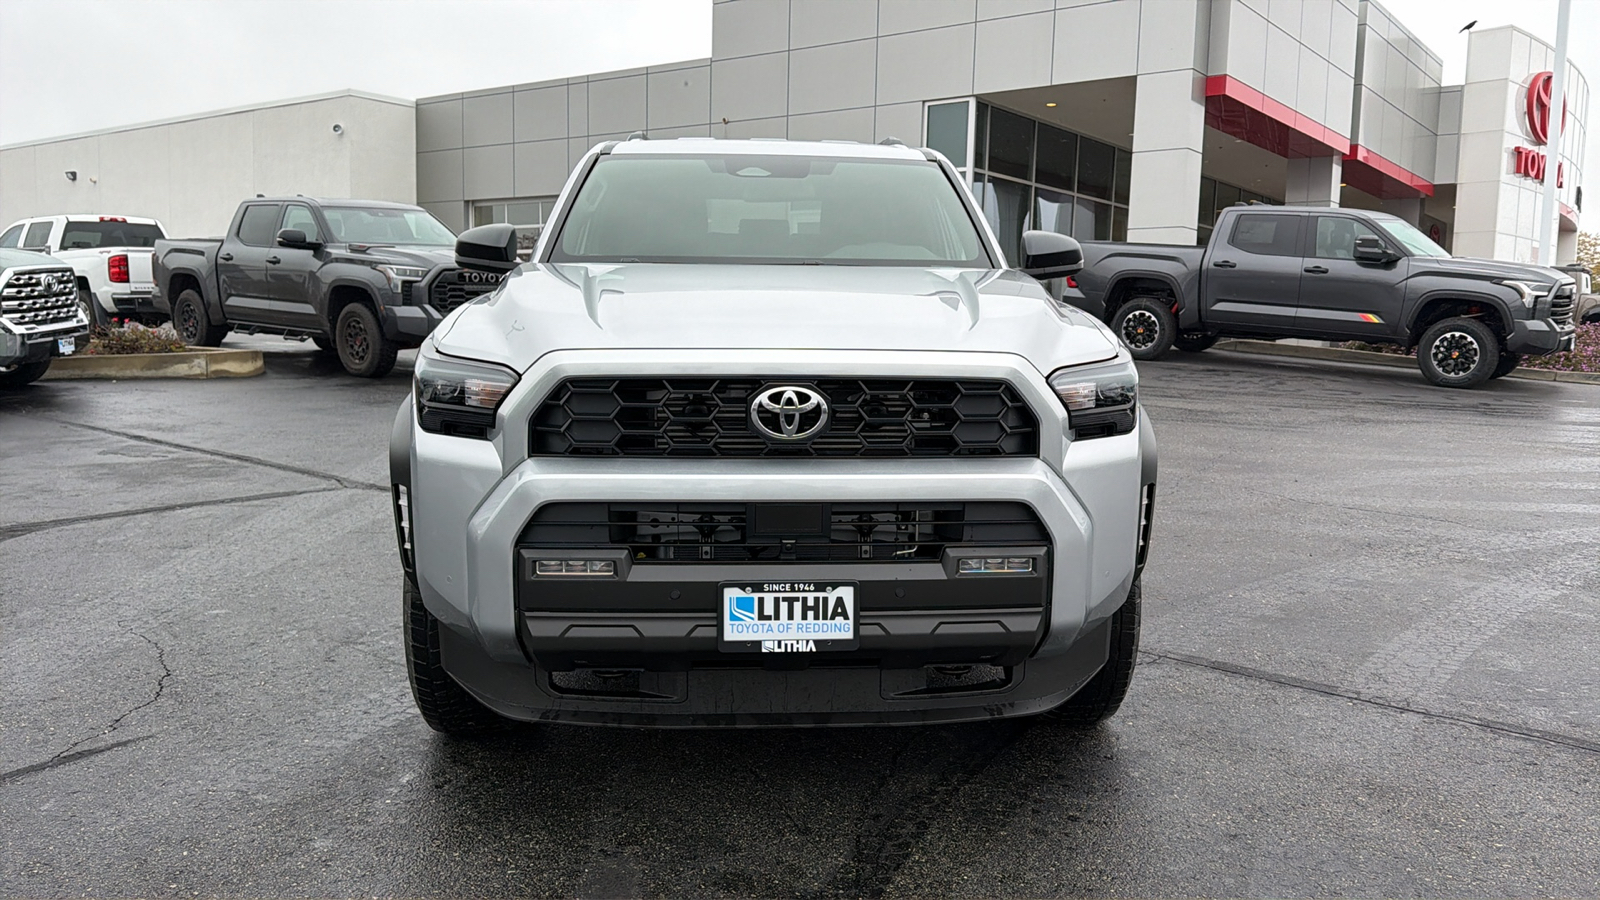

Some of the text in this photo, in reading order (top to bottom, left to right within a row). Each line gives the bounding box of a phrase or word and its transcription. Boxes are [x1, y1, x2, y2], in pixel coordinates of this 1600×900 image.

[1514, 146, 1564, 189] TOYA
[463, 272, 502, 283] TOYO
[763, 583, 815, 592] SINCE 1946
[757, 596, 850, 621] LITHIA
[729, 622, 851, 634] TOYOTA OF REDDING
[773, 639, 817, 652] LITHIA
